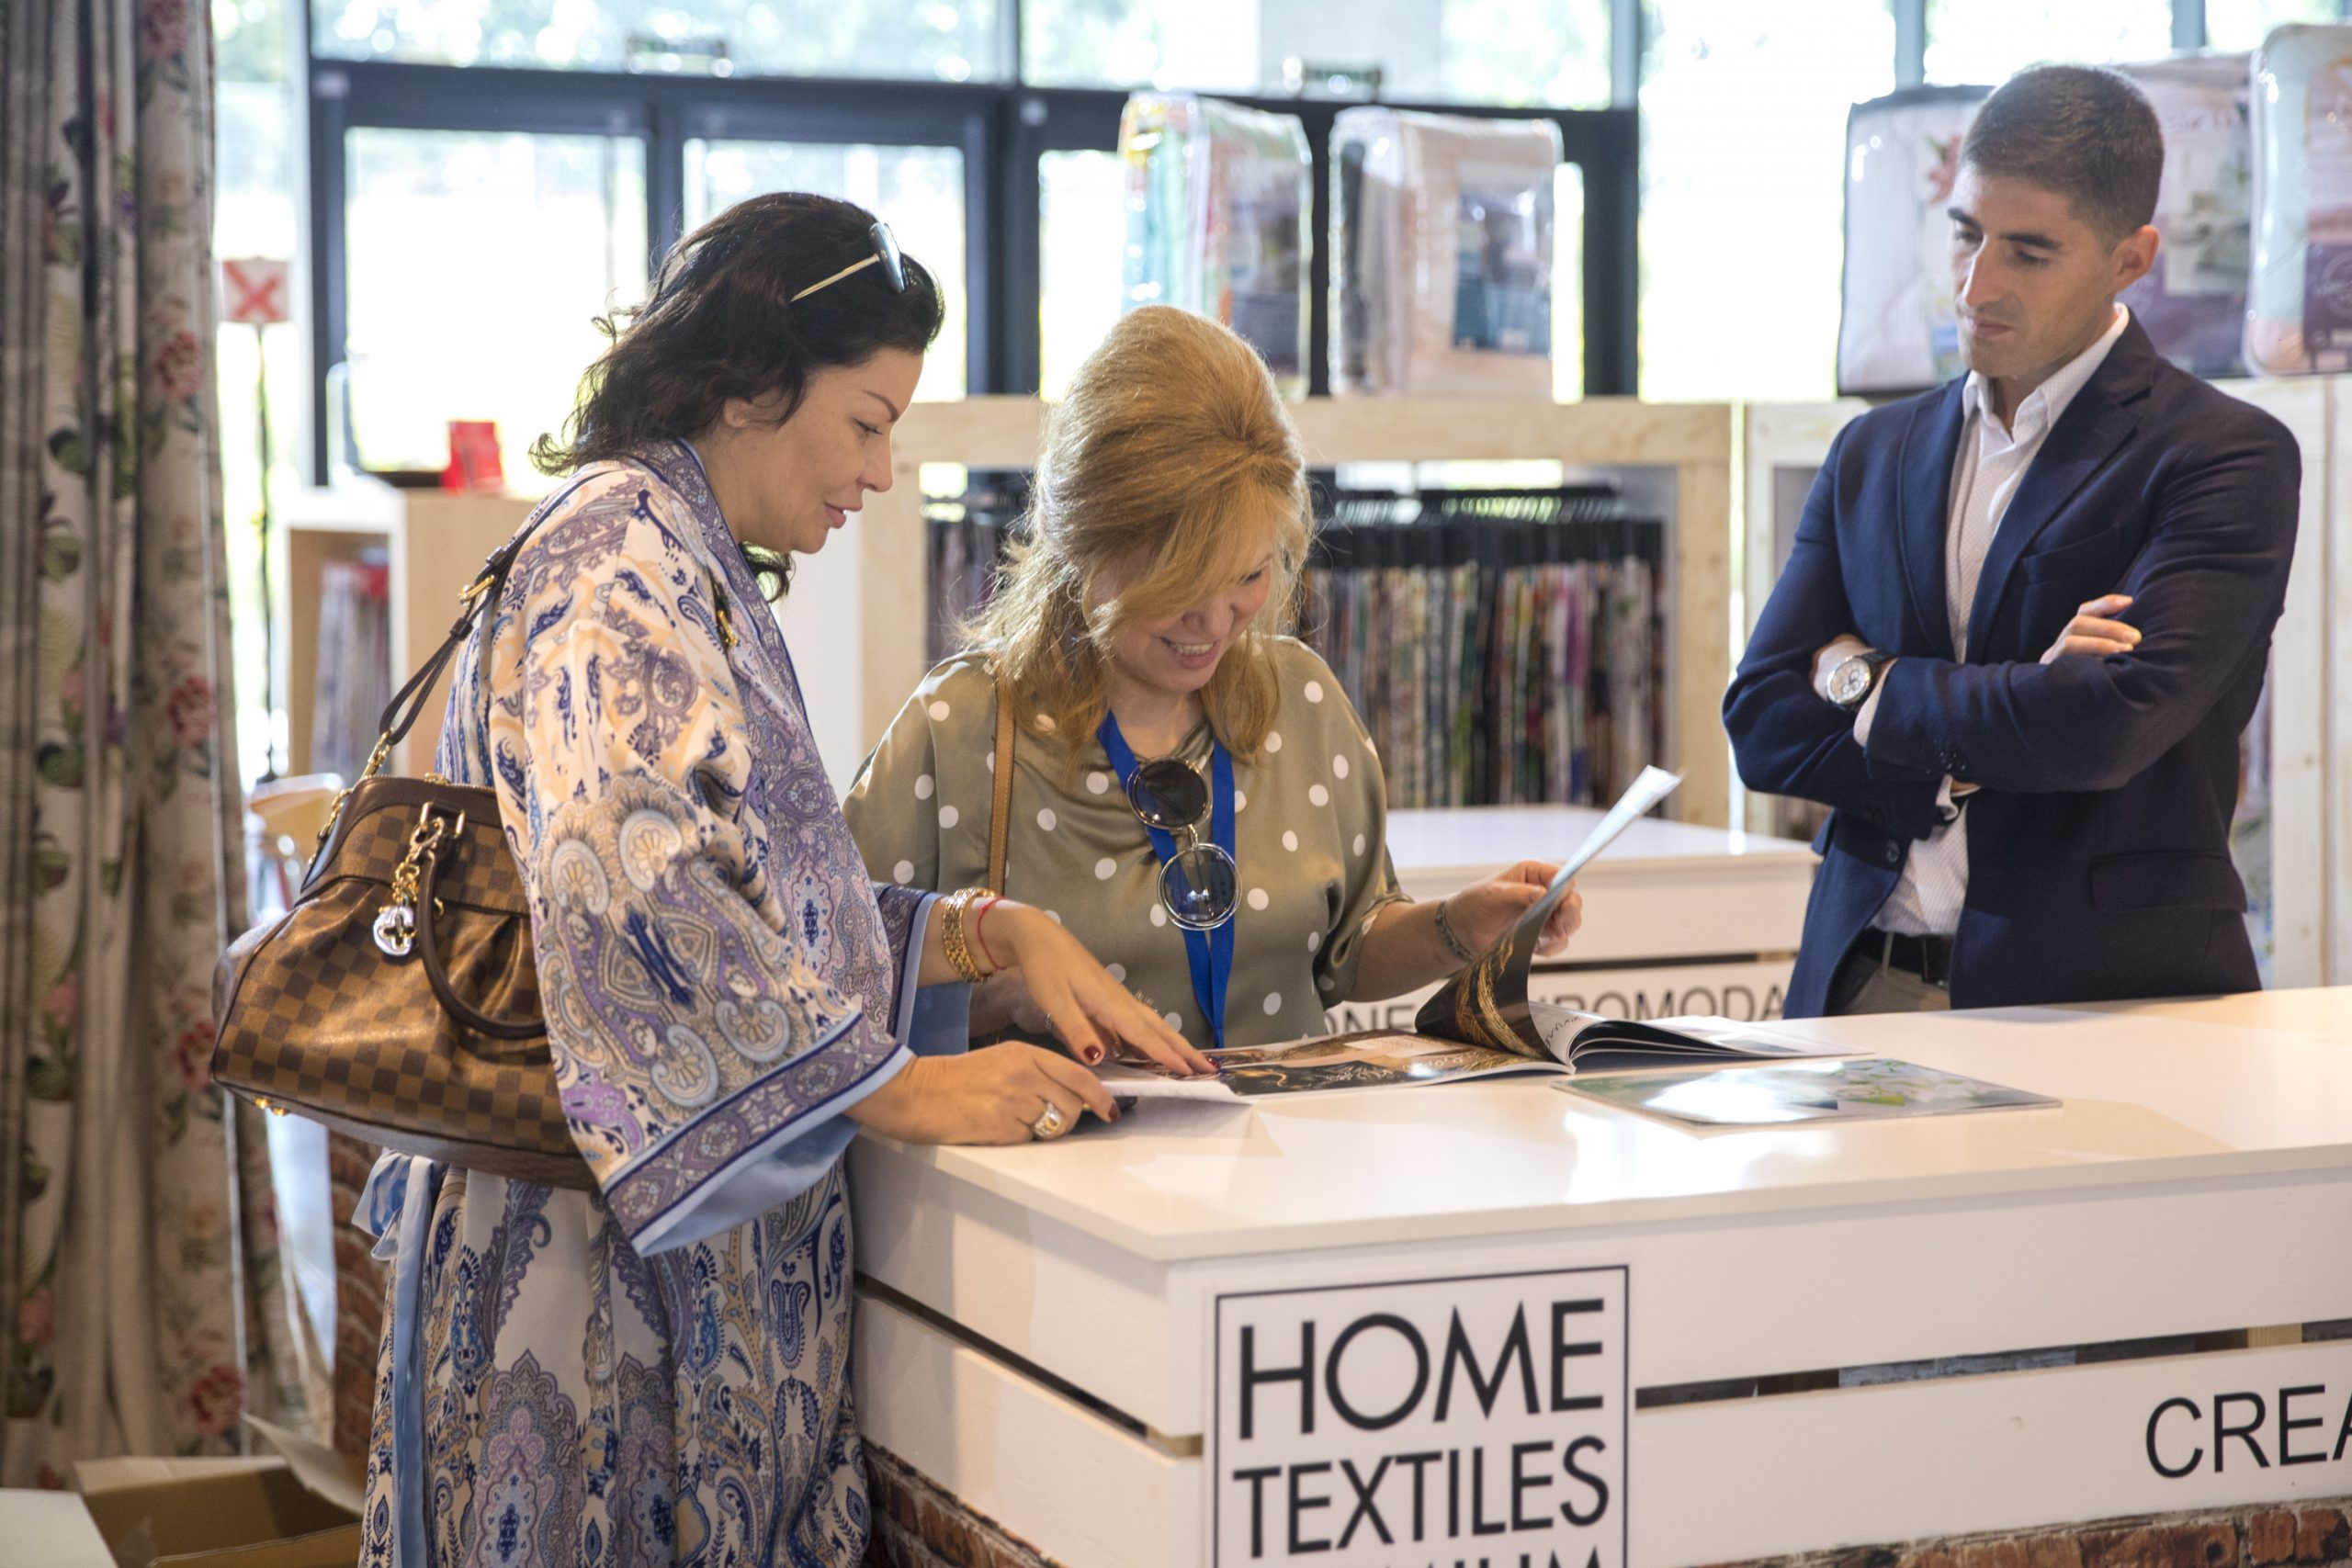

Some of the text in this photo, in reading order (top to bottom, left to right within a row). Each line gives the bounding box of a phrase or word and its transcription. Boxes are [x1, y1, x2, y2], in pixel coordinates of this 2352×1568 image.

[1239, 1298, 1604, 1439] HOME
[2145, 1383, 2352, 1479] CRE
[1232, 1435, 1610, 1559] TEXTILES
